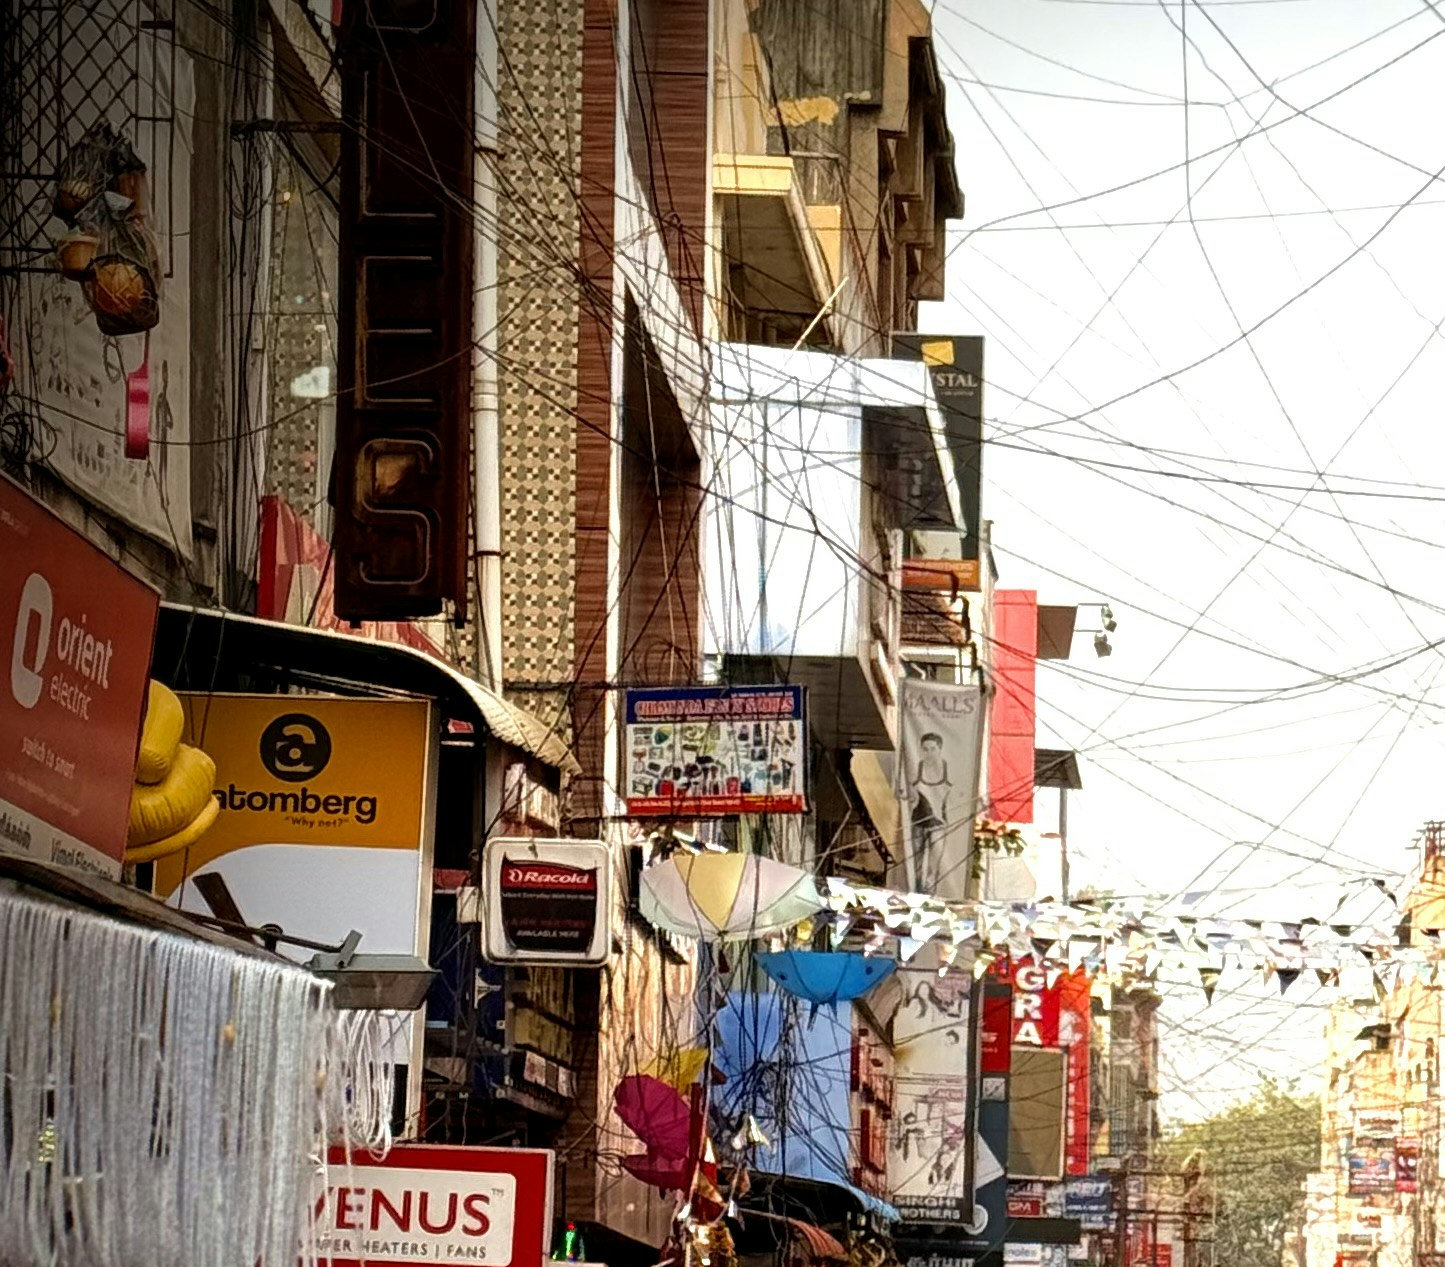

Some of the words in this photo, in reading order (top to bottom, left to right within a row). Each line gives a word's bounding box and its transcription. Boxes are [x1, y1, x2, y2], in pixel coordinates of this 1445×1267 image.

[57, 613, 113, 690] orient
[50, 672, 93, 721] electric
[211, 783, 378, 825] atomberg
[523, 871, 590, 884] Racold
[900, 1208, 961, 1220] ROTHERS
[447, 1244, 487, 1260] FANS
